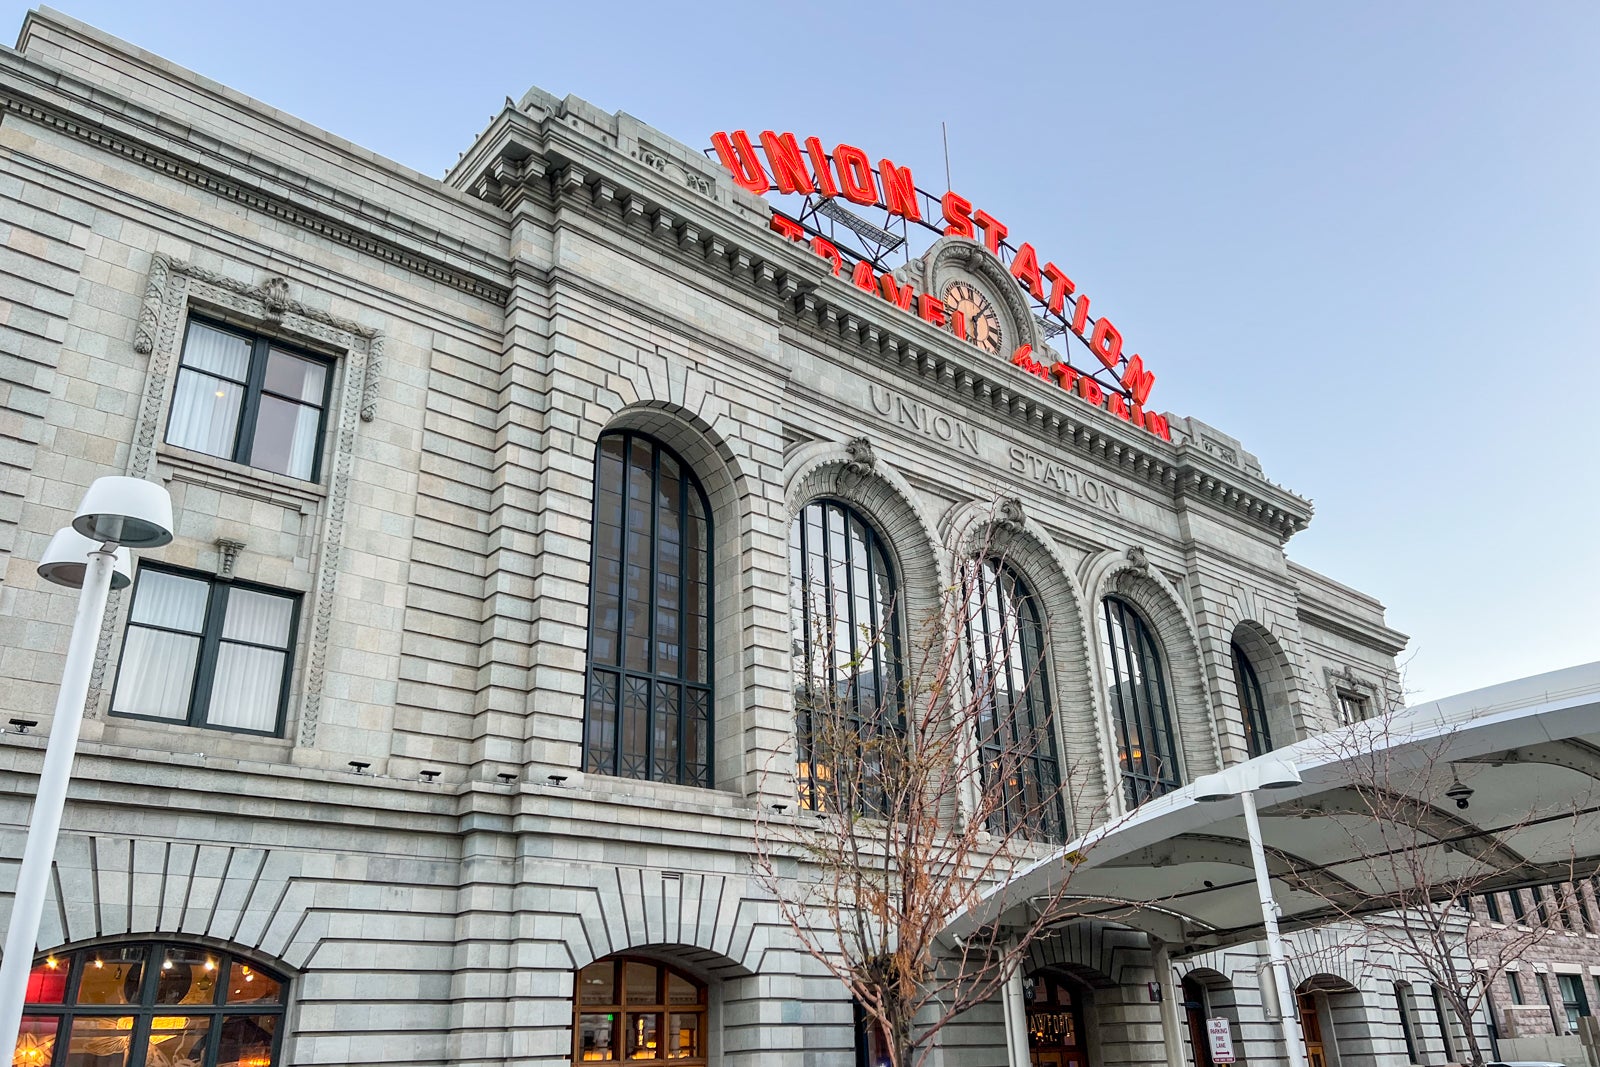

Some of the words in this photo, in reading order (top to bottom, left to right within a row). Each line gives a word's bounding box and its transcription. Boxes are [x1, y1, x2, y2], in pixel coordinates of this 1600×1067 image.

[710, 130, 920, 222] UNION
[941, 190, 1155, 406] STATION
[869, 385, 979, 454] UNION
[1009, 447, 1122, 513] STATION
[1051, 361, 1171, 442] TRAIN
